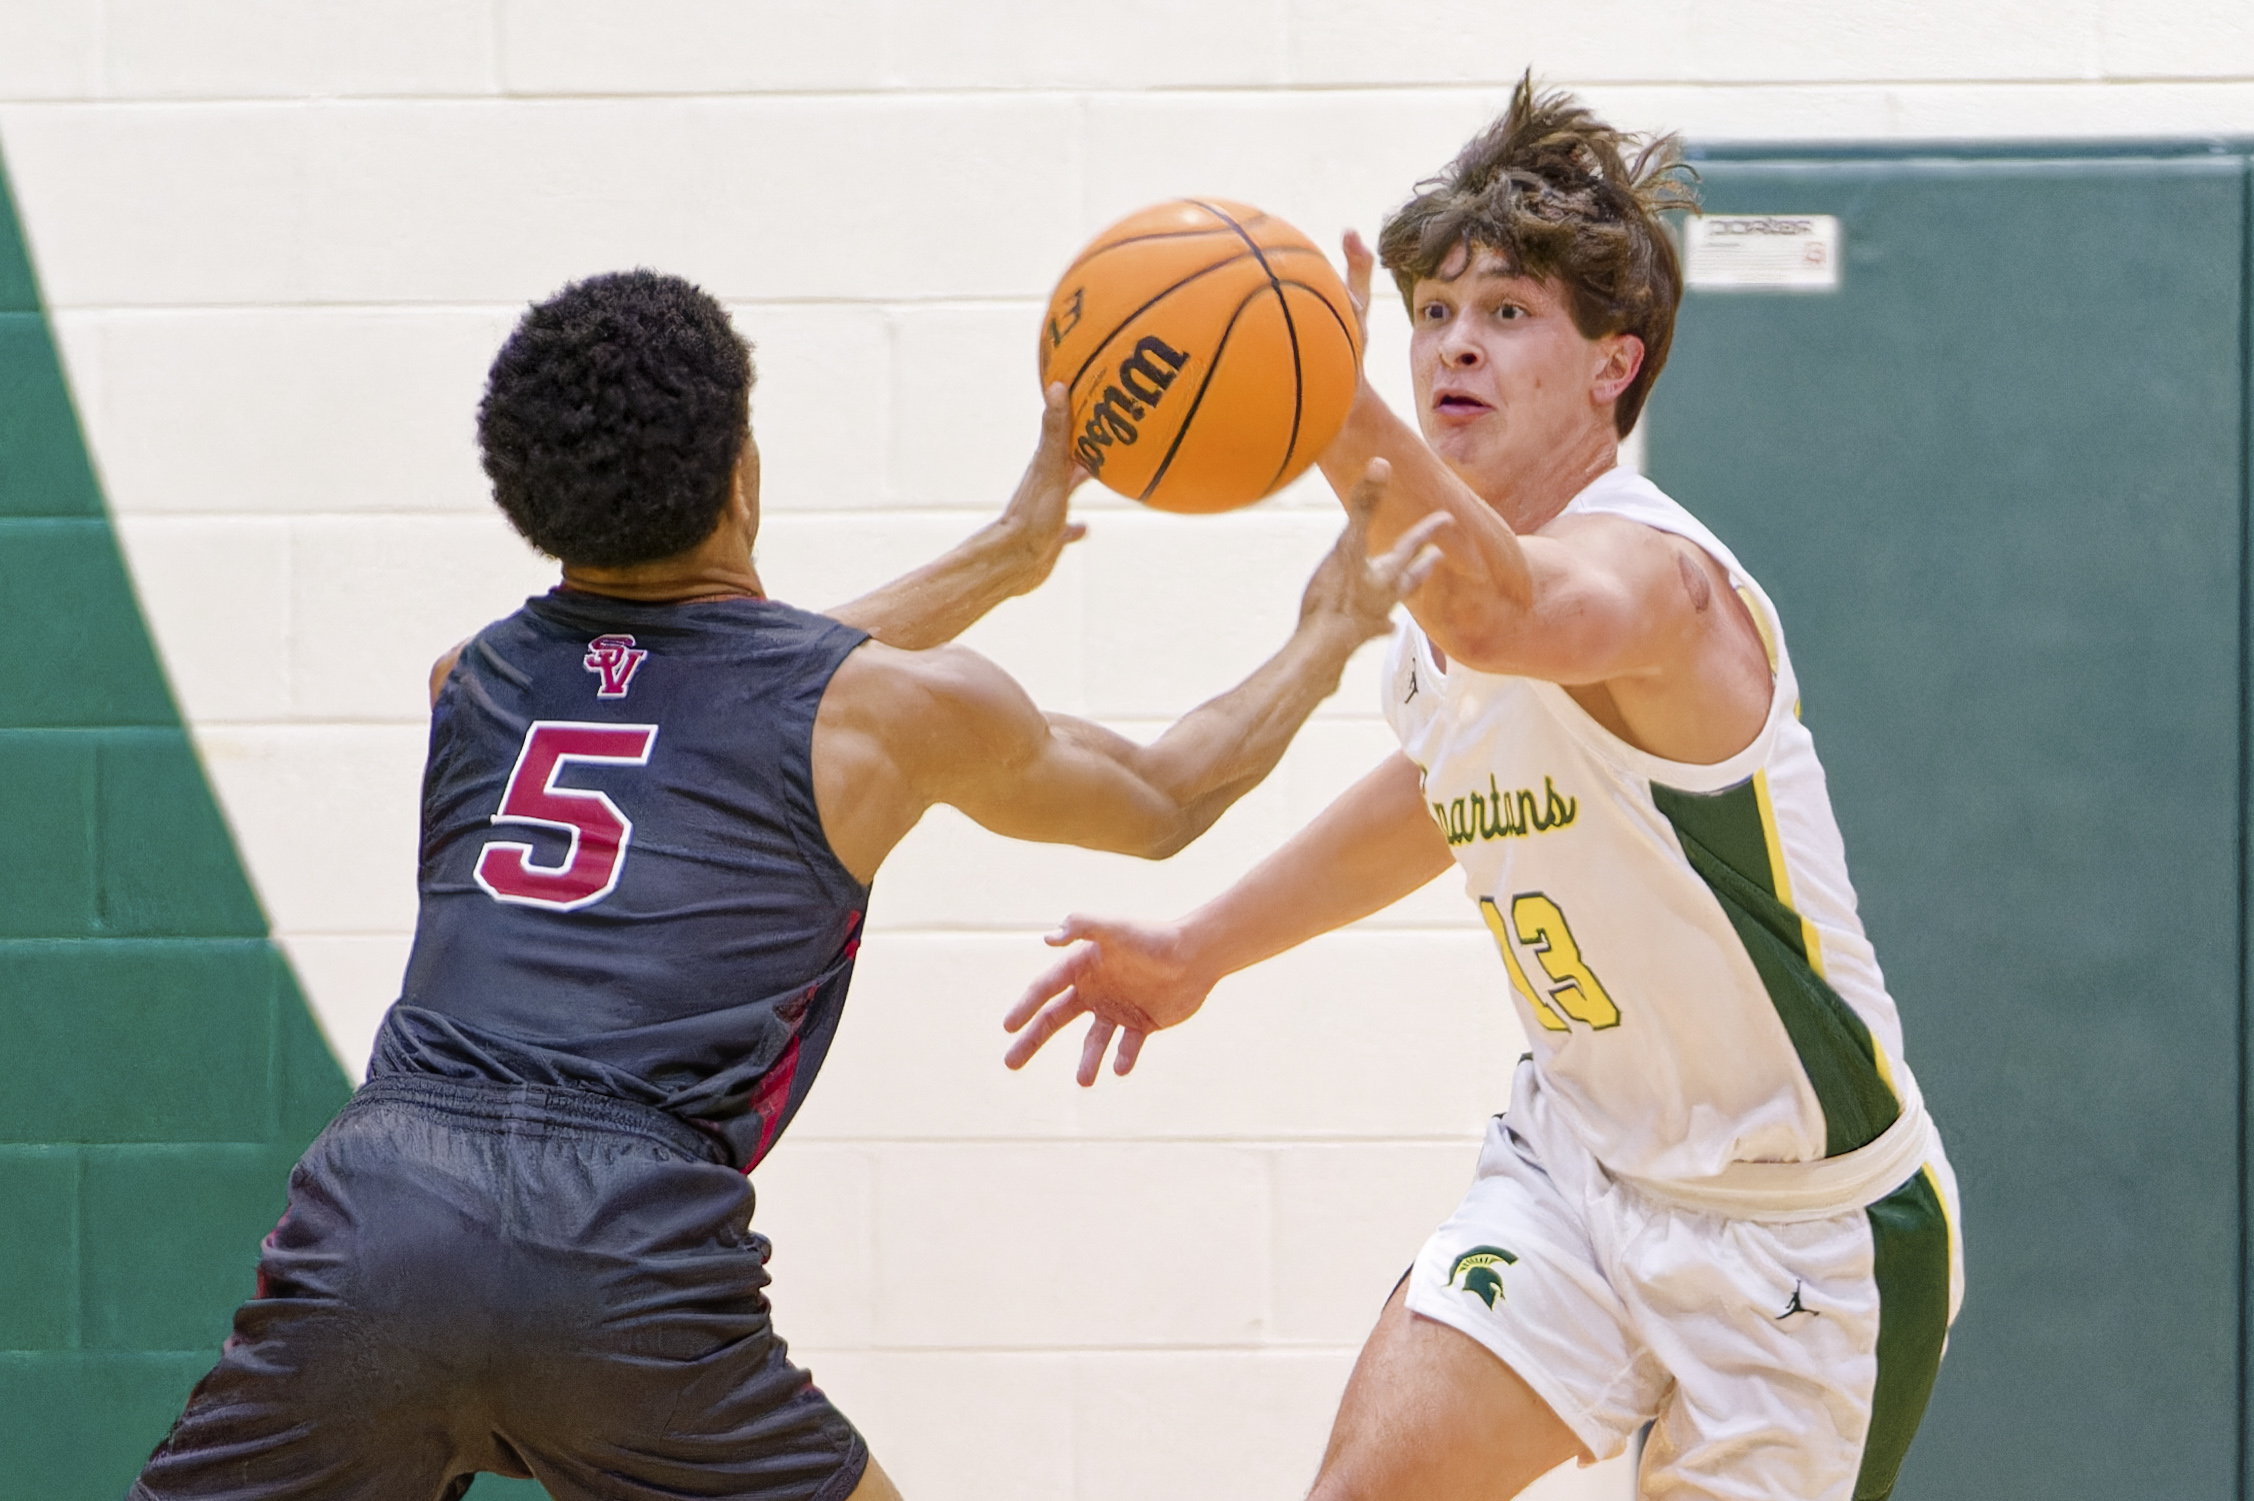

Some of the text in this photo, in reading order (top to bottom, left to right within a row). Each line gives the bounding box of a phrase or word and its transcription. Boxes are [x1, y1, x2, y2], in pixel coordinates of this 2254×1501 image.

[583, 633, 648, 699] SV
[473, 719, 659, 913] 5
[1480, 890, 1621, 1032] 13
